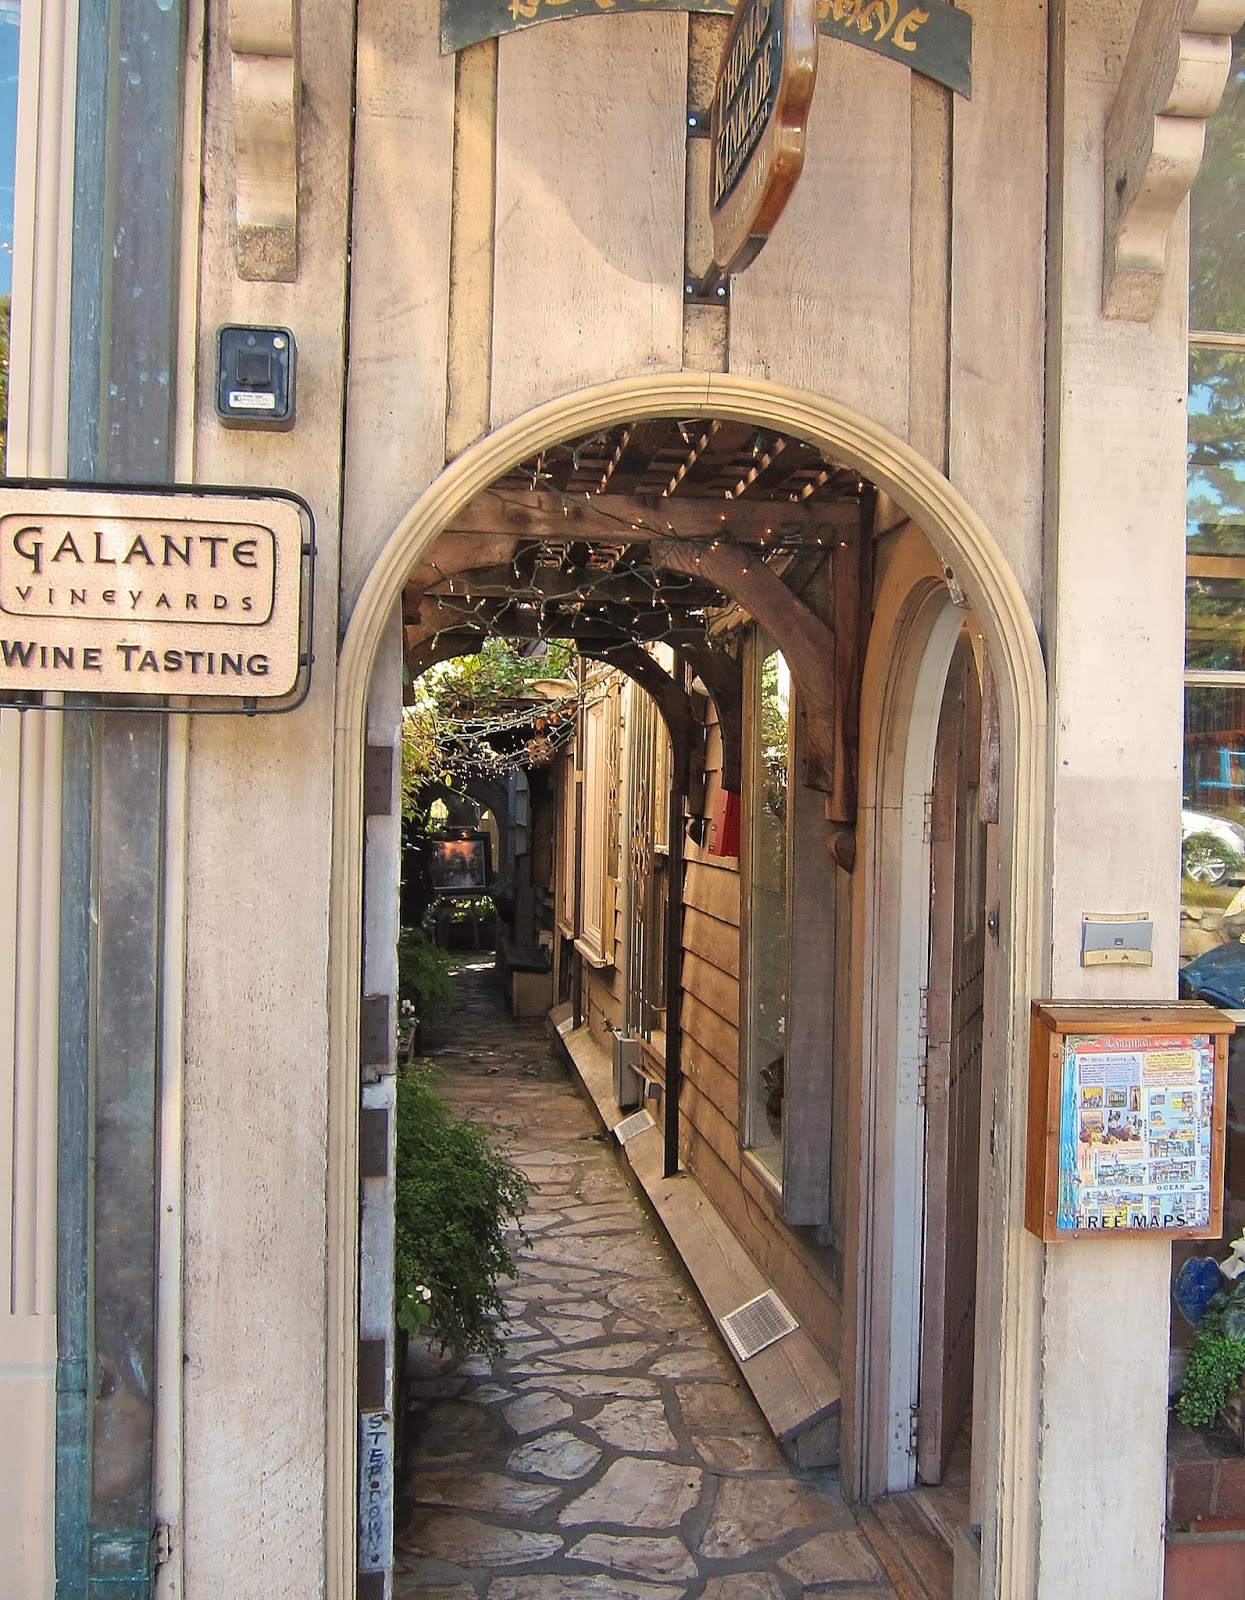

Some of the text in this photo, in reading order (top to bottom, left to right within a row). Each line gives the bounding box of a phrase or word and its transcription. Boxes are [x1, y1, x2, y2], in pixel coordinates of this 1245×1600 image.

[714, 34, 772, 207] KINKADE
[13, 527, 258, 574] GALANTE
[16, 586, 252, 610] VINEYARDS
[1, 640, 269, 676] WINE TASTING
[1105, 1037, 1152, 1049] Carmel
[1156, 1184, 1186, 1192] OCEAN
[1075, 1213, 1186, 1229] FREE MAPS
